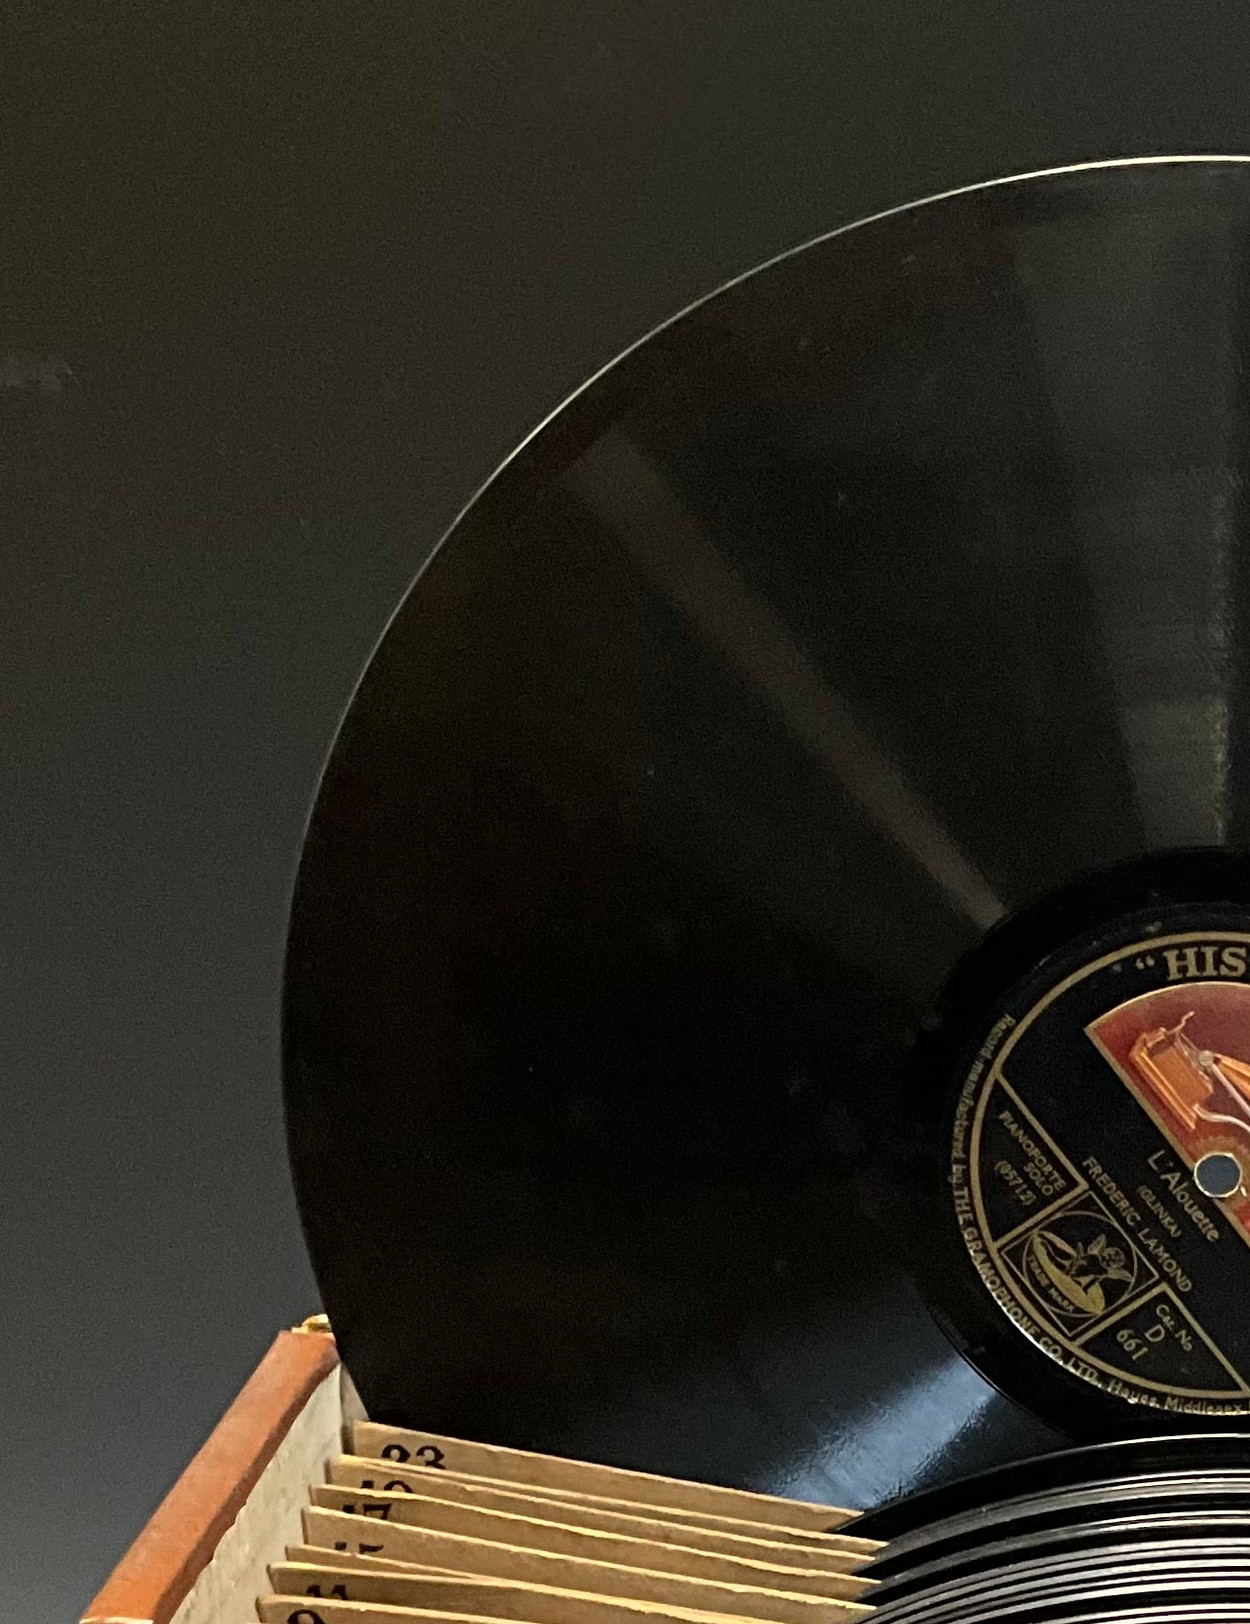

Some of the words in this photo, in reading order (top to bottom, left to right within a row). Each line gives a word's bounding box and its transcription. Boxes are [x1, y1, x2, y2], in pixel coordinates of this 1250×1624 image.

[999, 1110, 1067, 1192] PIANOFORTE
[1023, 1162, 1054, 1196] SOLO
[952, 1186, 974, 1225] THE
[1082, 1156, 1141, 1226] FREDERIC
[1137, 1227, 1192, 1292] LAMOND
[1116, 1329, 1149, 1361] 661
[1144, 1324, 1165, 1343] D
